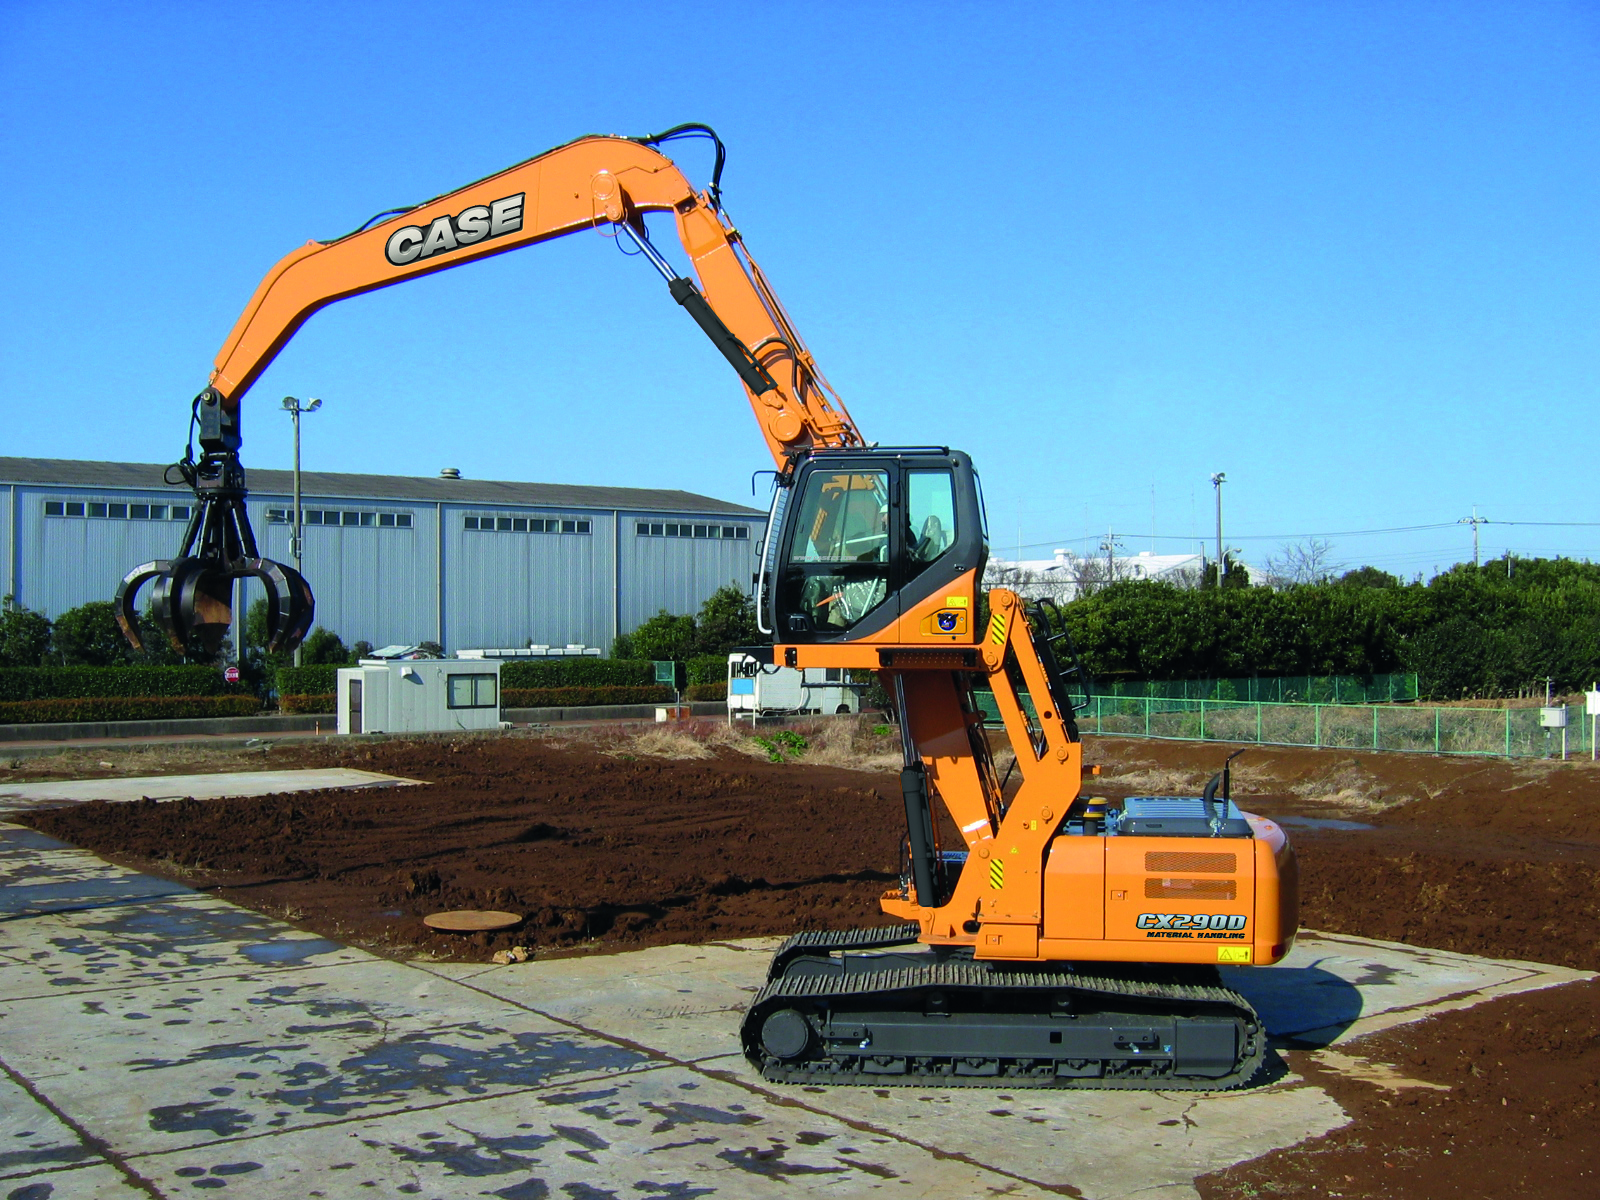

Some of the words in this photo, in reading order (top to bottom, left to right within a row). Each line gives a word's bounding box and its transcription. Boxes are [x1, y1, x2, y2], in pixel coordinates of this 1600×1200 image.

[385, 192, 525, 266] CASE
[1136, 913, 1247, 930] CX290D
[1146, 931, 1195, 939] MATERIAL
[1197, 932, 1246, 940] HANDLING
